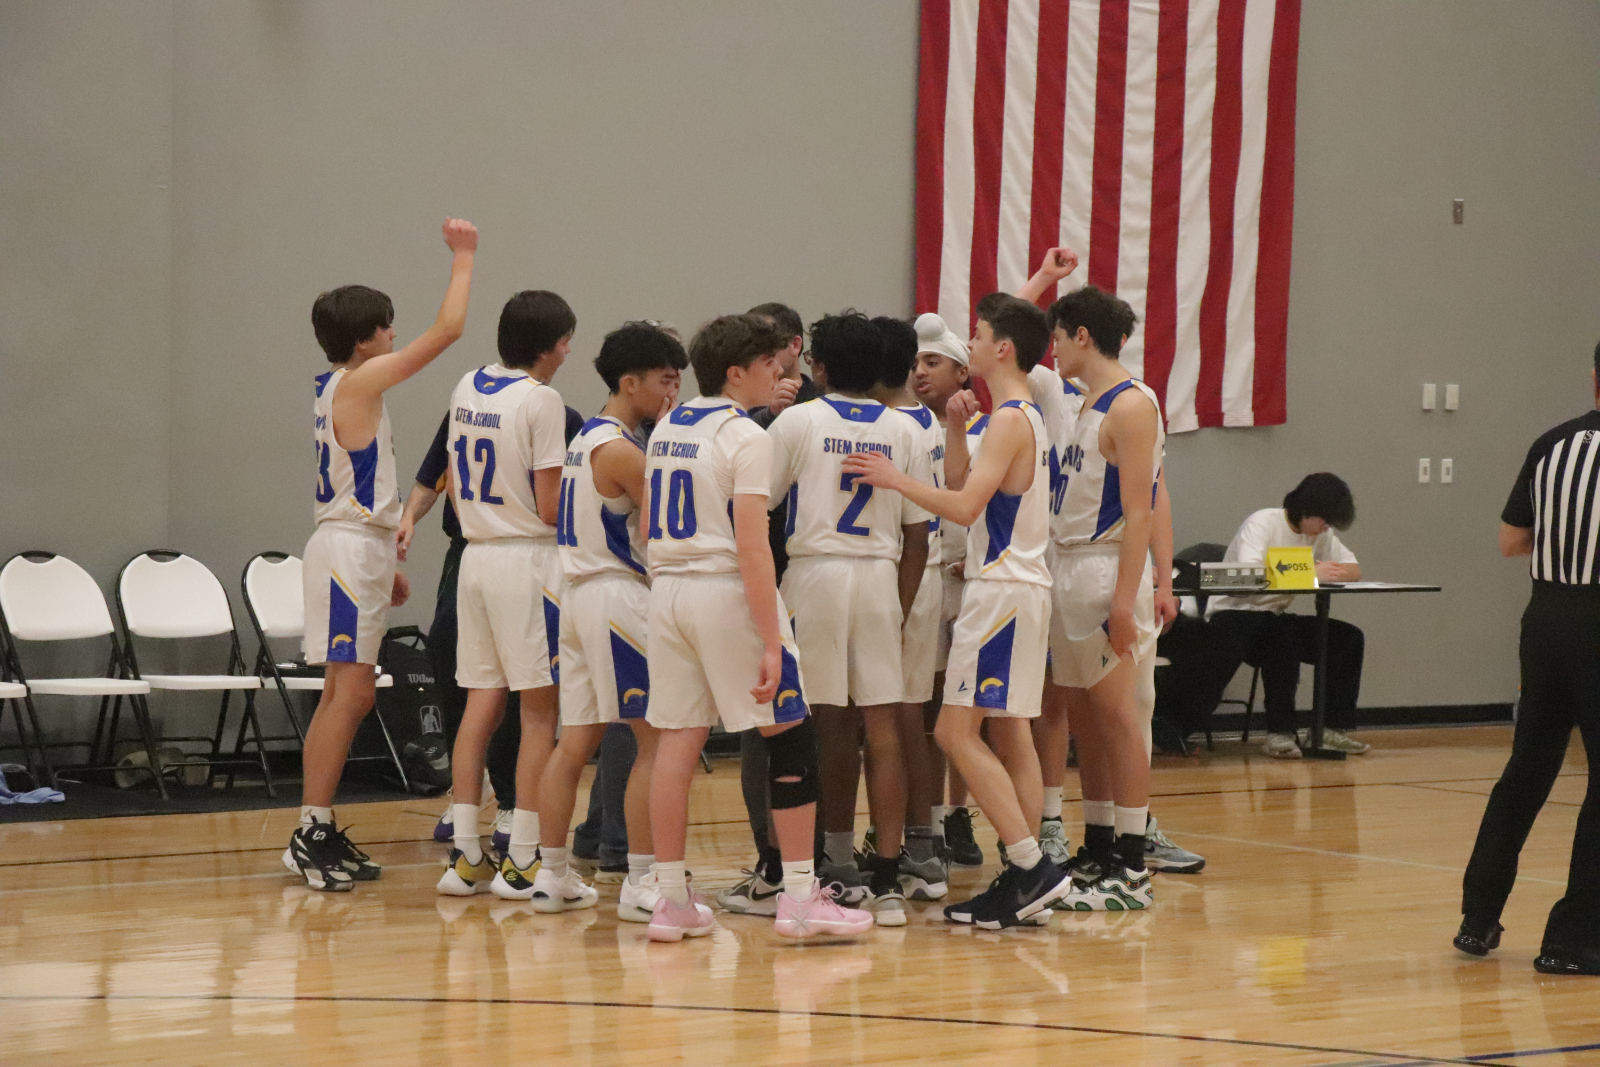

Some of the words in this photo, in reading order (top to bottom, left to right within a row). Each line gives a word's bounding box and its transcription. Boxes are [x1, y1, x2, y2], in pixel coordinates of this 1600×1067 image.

[455, 407, 473, 425] STEM
[473, 412, 501, 429] SCHOOL
[671, 441, 700, 459] SCHOOL
[823, 437, 852, 454] STEM
[453, 434, 504, 505] 12
[557, 477, 578, 547] 11
[648, 468, 697, 540] 10
[836, 472, 874, 536] 2
